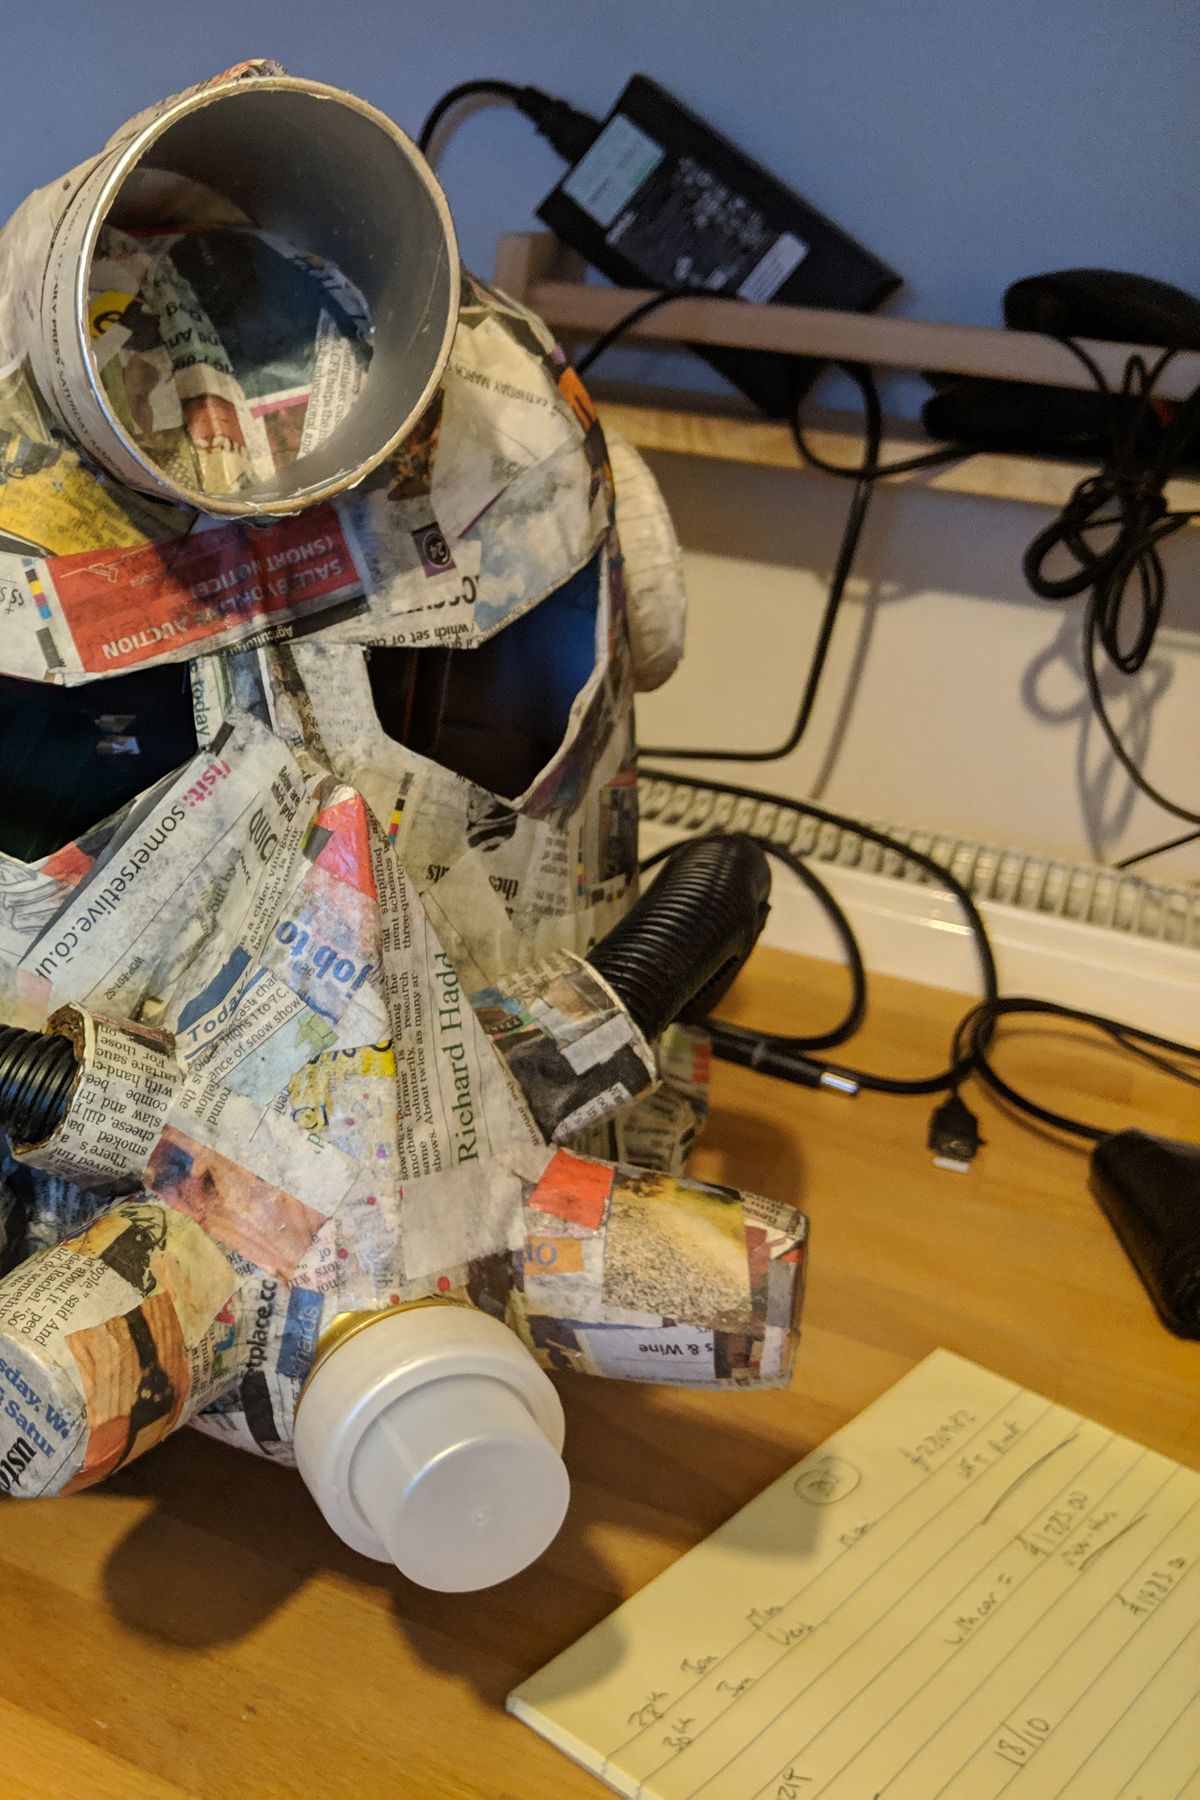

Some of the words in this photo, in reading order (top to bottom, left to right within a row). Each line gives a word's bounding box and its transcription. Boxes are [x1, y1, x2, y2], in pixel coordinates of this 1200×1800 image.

[291, 557, 343, 589] SALE
[99, 613, 190, 661] AUCTION
[410, 629, 430, 643] set
[433, 622, 469, 642] which
[192, 680, 211, 736] today
[33, 801, 190, 982] somersetlive.co.u
[247, 906, 270, 943] given
[266, 876, 283, 902] you
[284, 826, 299, 851] our
[249, 880, 272, 918] cider
[385, 858, 398, 912] schemes
[270, 918, 312, 957] to
[392, 917, 401, 950] ment
[305, 942, 374, 1000] job
[389, 973, 399, 993] the
[256, 1001, 272, 1017] to
[400, 971, 412, 1027] research
[412, 991, 421, 1027] many
[392, 1002, 404, 1040] doing
[99, 1035, 137, 1056] those
[231, 1042, 247, 1058] of
[244, 1020, 274, 1048] snow
[415, 1030, 421, 1044] as
[140, 1050, 166, 1068] For
[397, 1049, 405, 1060] is
[416, 1047, 427, 1082] twice
[123, 1087, 169, 1112] combe
[143, 1078, 173, 1098] with
[178, 1088, 197, 1110] the
[400, 1071, 411, 1116] farmer
[440, 1040, 480, 1164] Richard
[81, 1107, 106, 1124] dill
[99, 1096, 127, 1114] and
[129, 1107, 163, 1129] slaw
[206, 1085, 233, 1125] round
[421, 1084, 433, 1124] About
[107, 1114, 156, 1142] cheese,
[78, 1141, 128, 1167] There's
[95, 1130, 148, 1157] smoked
[403, 1125, 420, 1178] another
[428, 1128, 442, 1172] shows.
[38, 1260, 54, 1276] do
[53, 1265, 85, 1296] about
[48, 1292, 62, 1306] it
[53, 1293, 81, 1322] said
[638, 1343, 682, 1354] Wine
[686, 1343, 698, 1354] &
